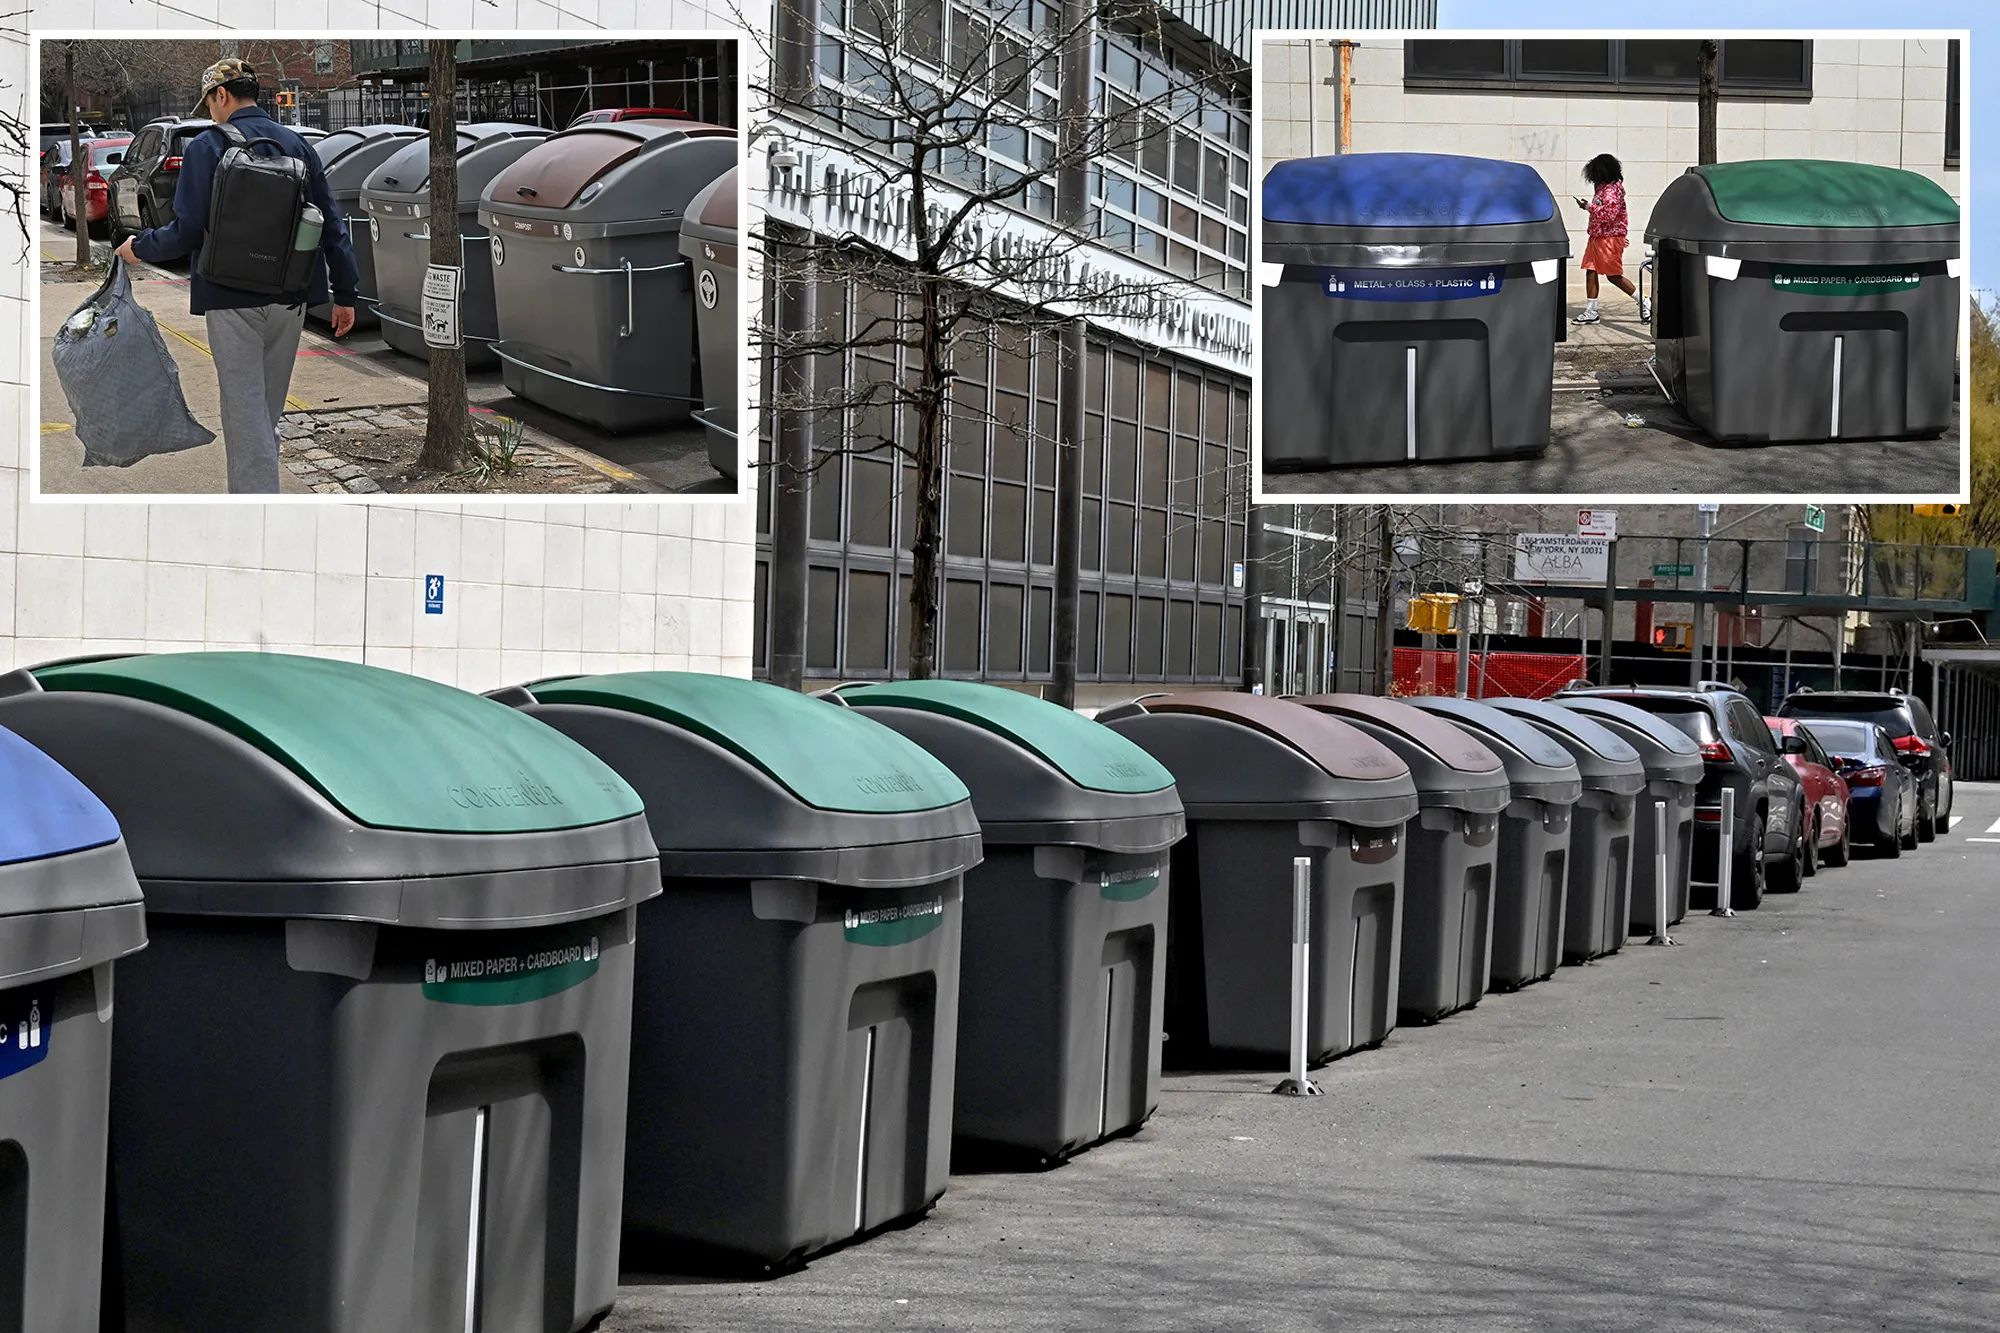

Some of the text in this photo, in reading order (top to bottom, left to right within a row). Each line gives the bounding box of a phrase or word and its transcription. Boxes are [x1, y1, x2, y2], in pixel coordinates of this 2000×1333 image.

[432, 273, 451, 283] WASTE
[1793, 276, 1819, 284] MIXED
[1820, 276, 1847, 284] PAPER
[1854, 275, 1903, 284] CARDBOARD
[1353, 280, 1386, 289] METAL
[1395, 279, 1426, 288] GLASS
[1435, 279, 1473, 288] PLASTIC
[1568, 546, 1579, 554] NY
[1581, 546, 1603, 555] 10031
[1542, 555, 1583, 569] ALBA
[860, 909, 879, 924] MIXED
[880, 906, 898, 922] PAPER
[450, 959, 484, 979] MIXED
[486, 957, 518, 975] PAPER
[526, 945, 581, 970] CARDBOARD
